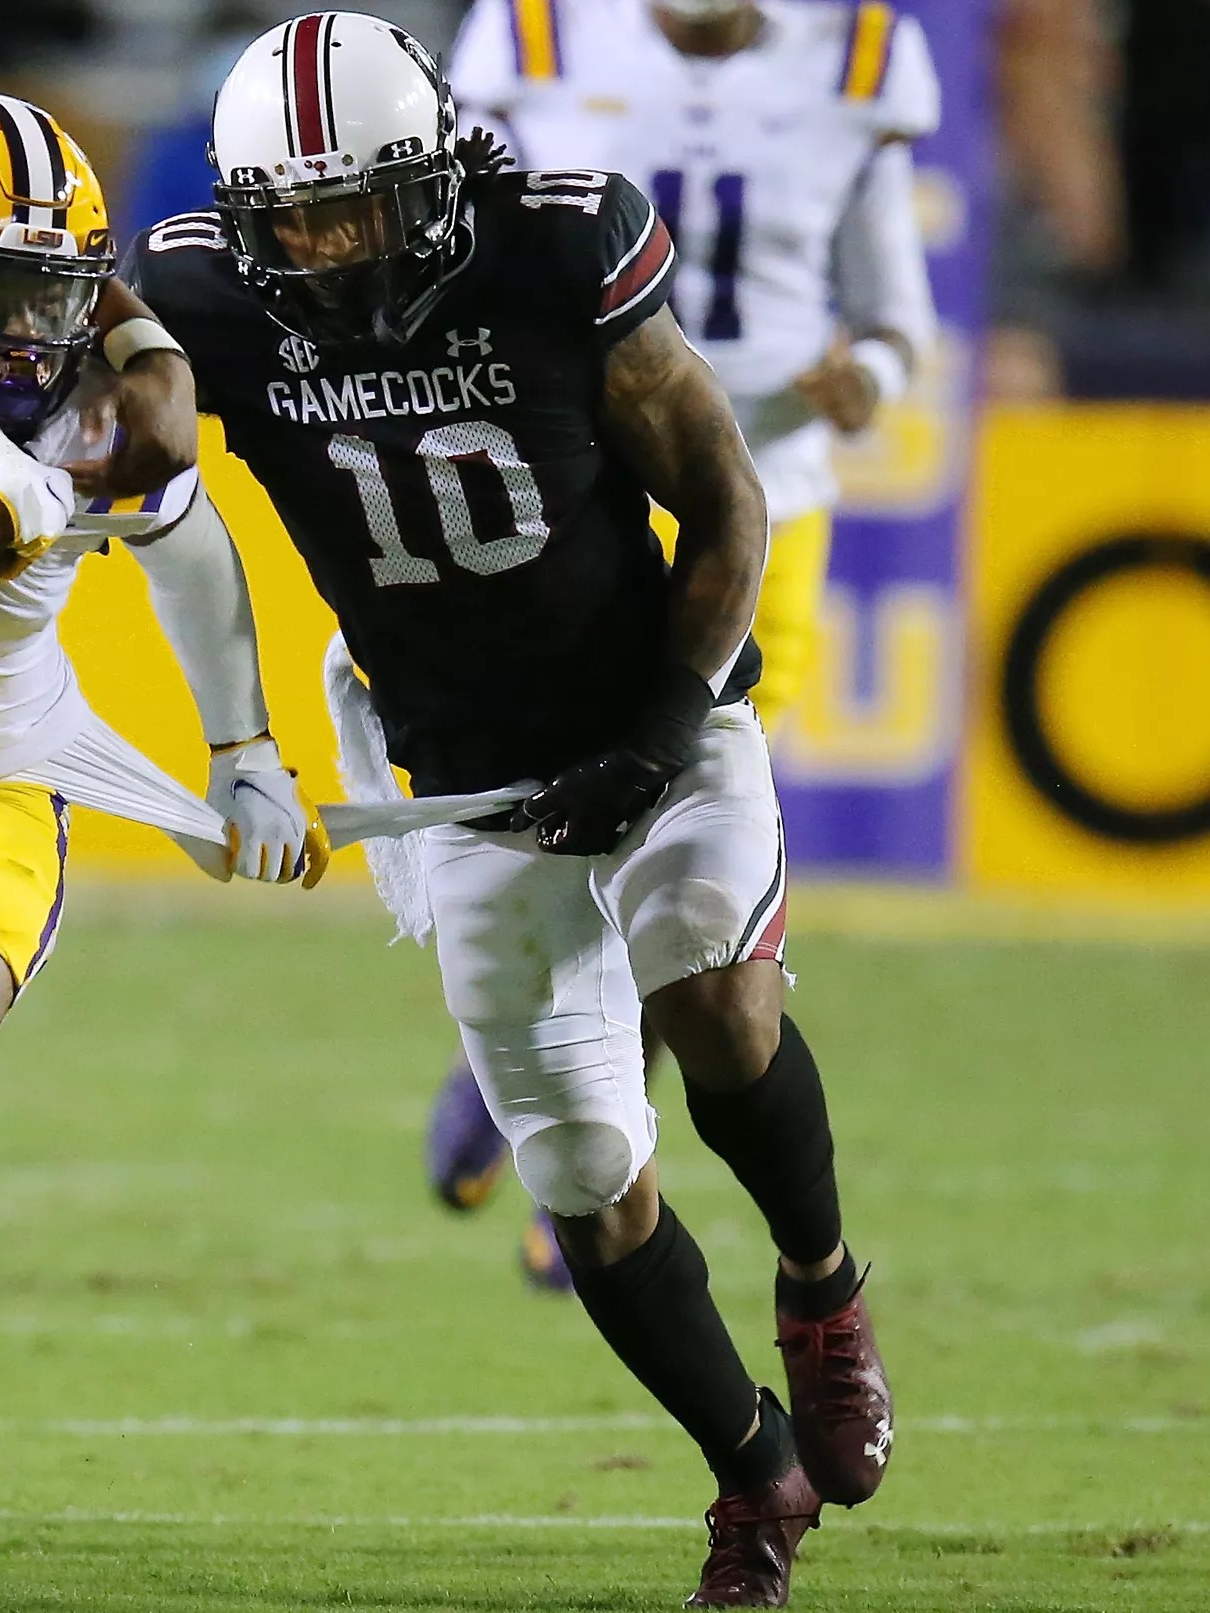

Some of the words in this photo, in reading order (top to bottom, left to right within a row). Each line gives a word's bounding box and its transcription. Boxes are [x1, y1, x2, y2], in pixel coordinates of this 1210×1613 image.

[520, 169, 609, 215] 10
[278, 335, 320, 374] SEC
[266, 362, 517, 424] GAMECOCKS
[327, 420, 551, 587] 10
